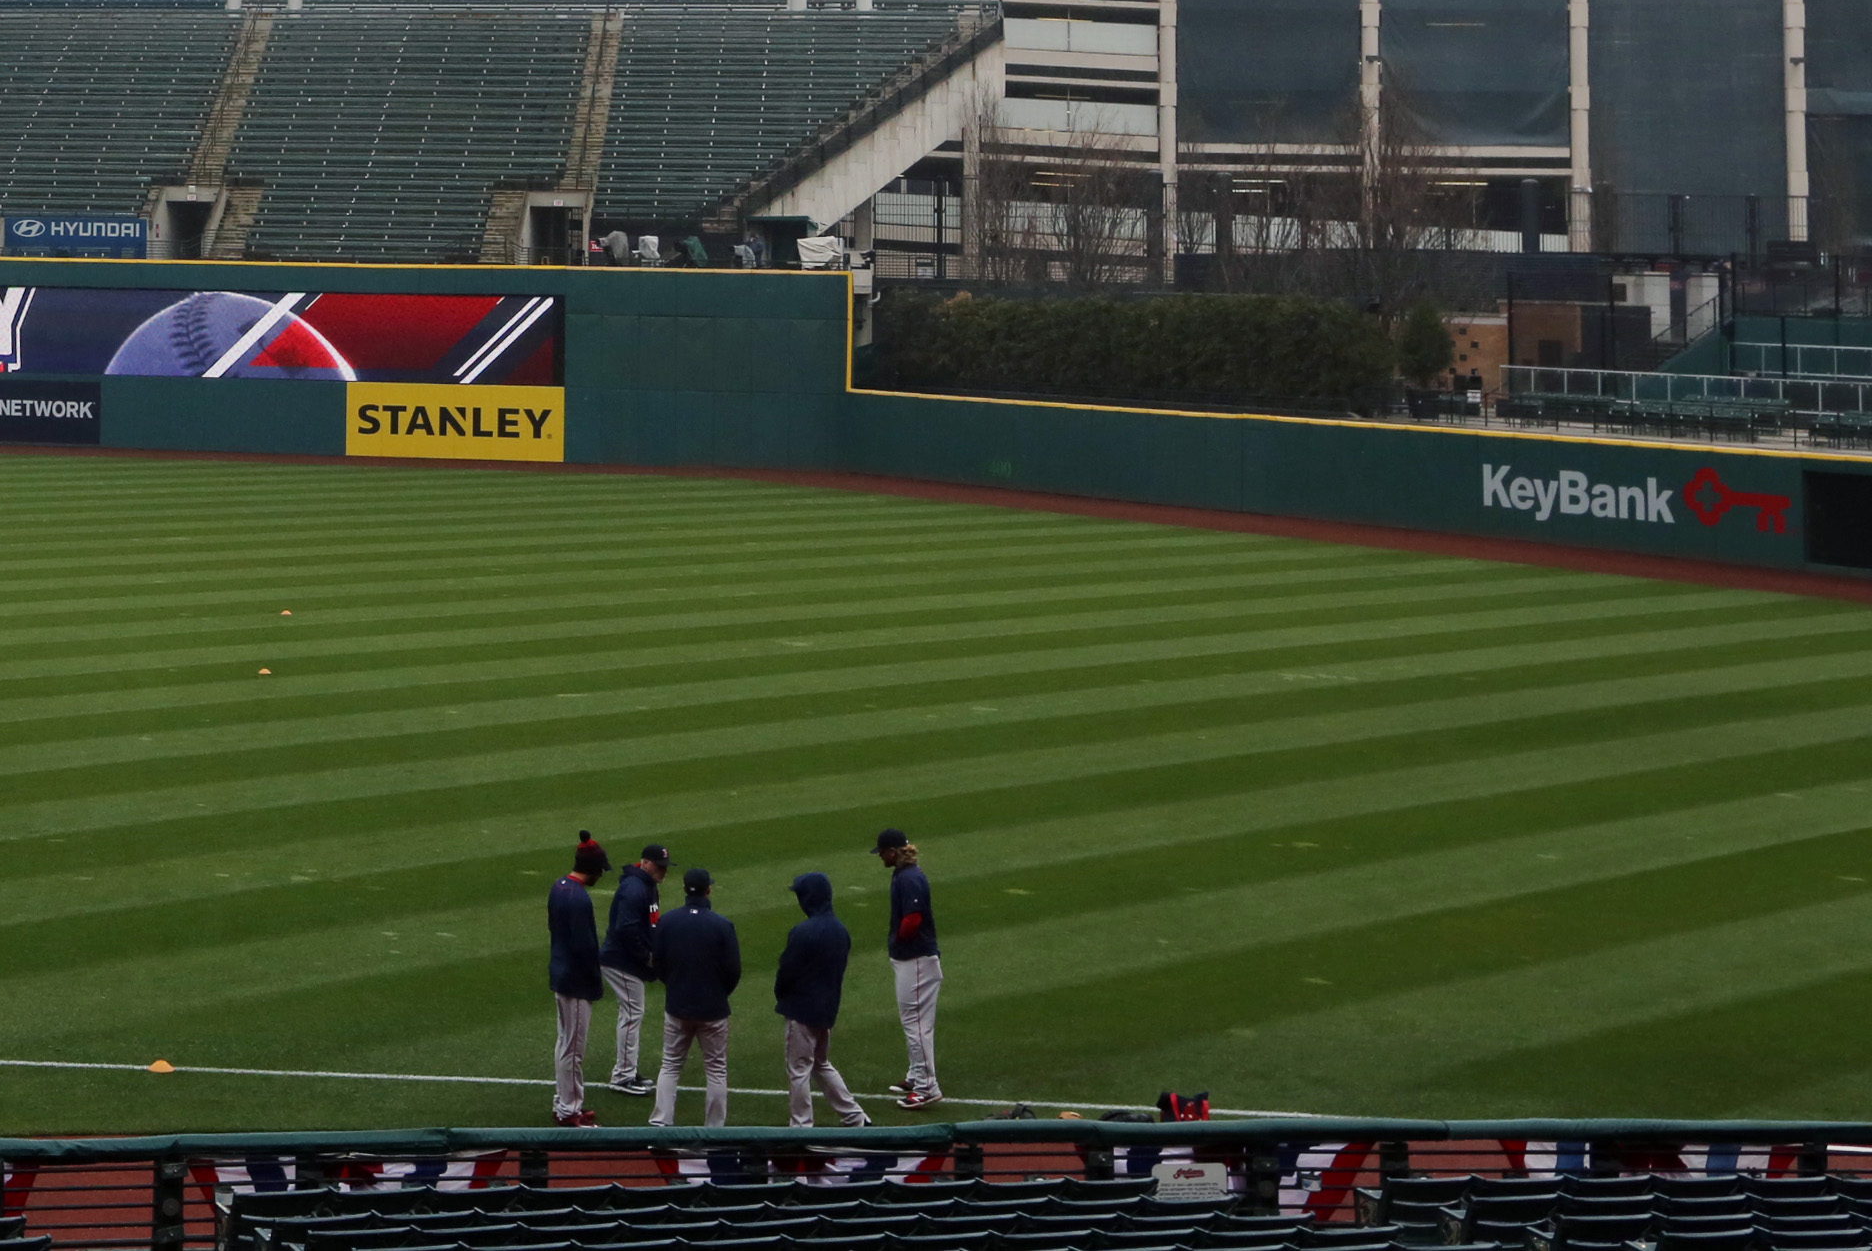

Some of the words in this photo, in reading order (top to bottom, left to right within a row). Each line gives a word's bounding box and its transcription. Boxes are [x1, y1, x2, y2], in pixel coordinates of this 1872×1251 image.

[50, 221, 140, 237] HYUNDAI
[357, 404, 552, 440] STANLEY
[1482, 463, 1676, 524] KeyBank
